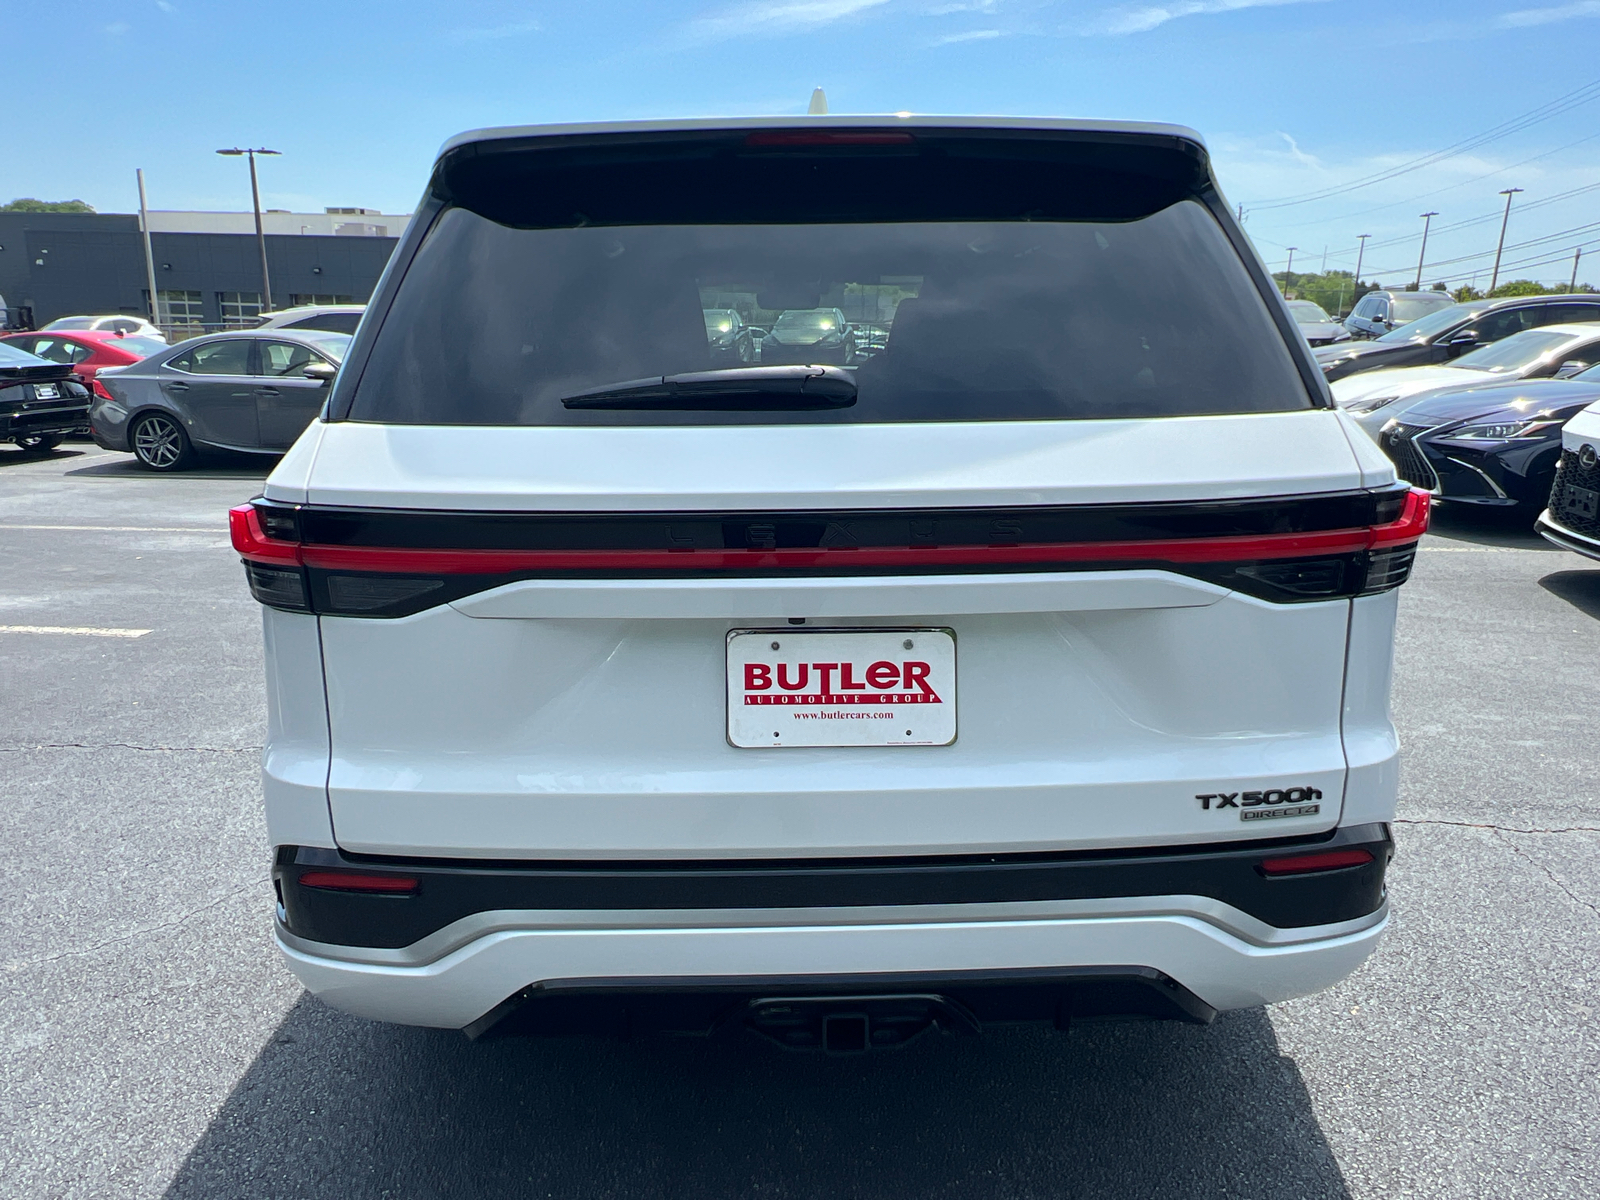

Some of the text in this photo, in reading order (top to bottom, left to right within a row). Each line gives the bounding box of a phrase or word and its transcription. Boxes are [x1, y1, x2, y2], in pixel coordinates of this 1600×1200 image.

[664, 519, 1023, 544] LEXUS
[745, 694, 936, 704] AUTOMOTIVE GROUP
[793, 711, 894, 720] www.butlercars.com
[1244, 805, 1319, 819] DIRECT4
